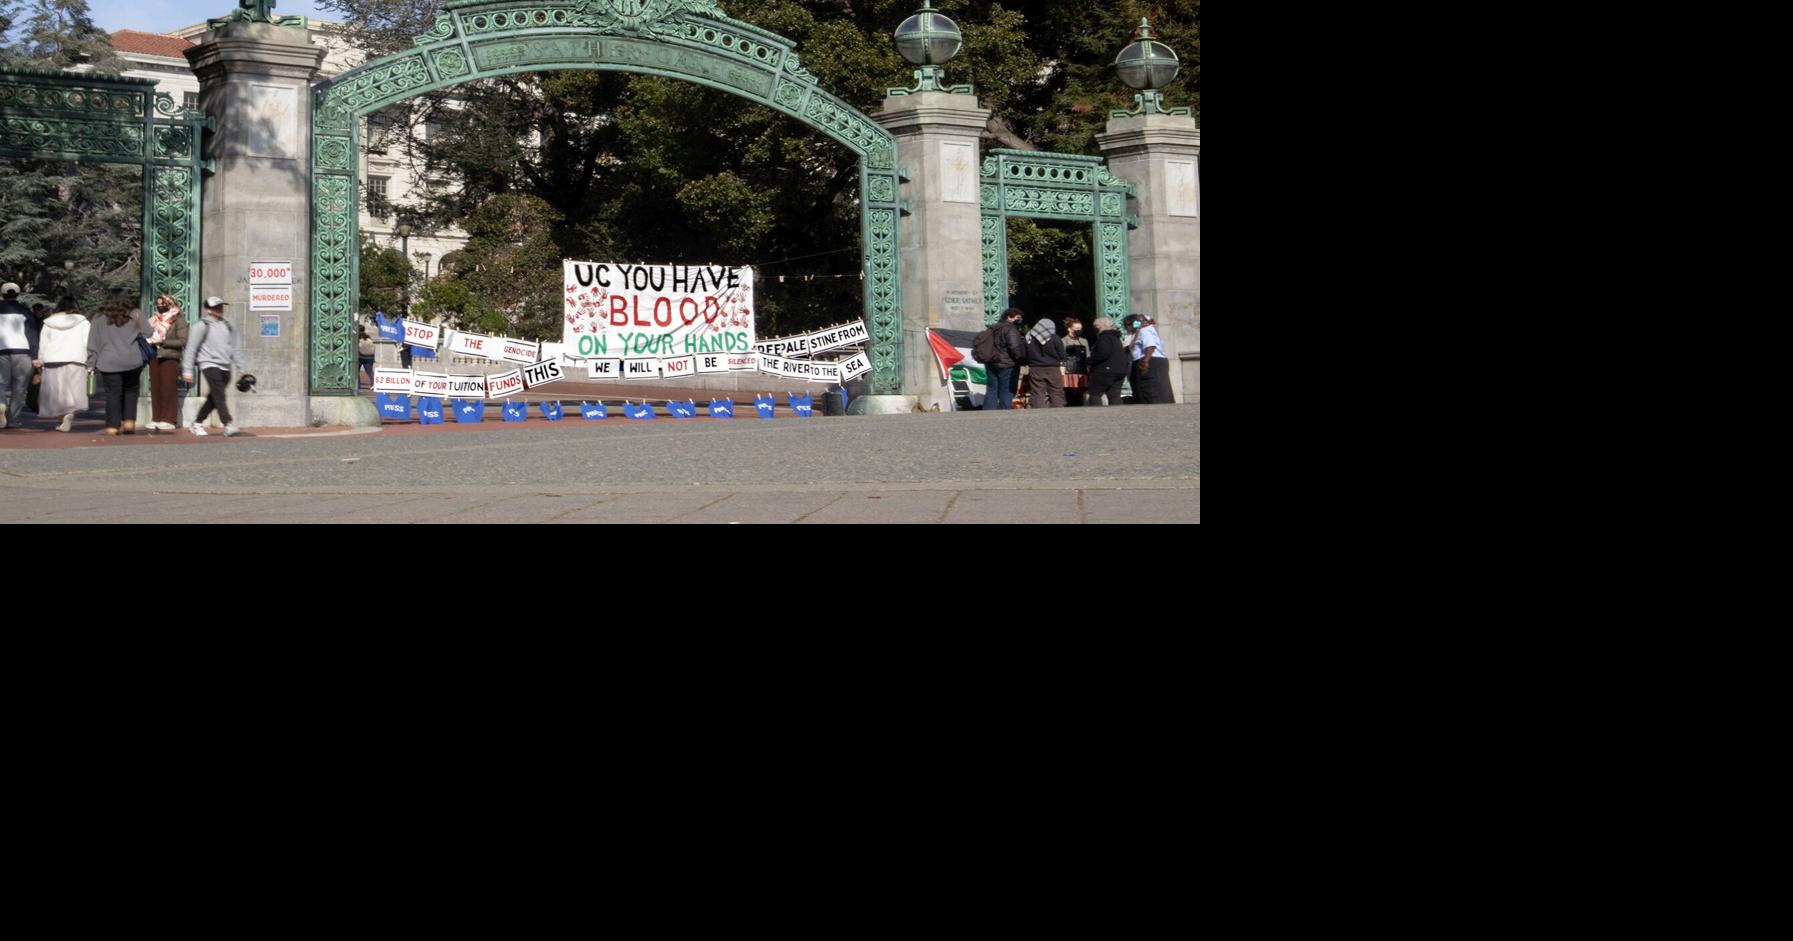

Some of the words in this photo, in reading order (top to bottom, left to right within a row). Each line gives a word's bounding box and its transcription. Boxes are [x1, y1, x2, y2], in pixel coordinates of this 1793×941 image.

[574, 264, 610, 288] UC
[616, 264, 665, 291] YOU
[673, 265, 740, 293] HAVE
[610, 295, 720, 327] BLOOD
[406, 327, 433, 341] STOP
[464, 337, 484, 350] THE
[503, 346, 536, 358] GENOCIDE
[578, 334, 607, 355] ON
[618, 332, 675, 356] YOUR
[685, 332, 749, 354] HANDS
[838, 325, 865, 341] FROM
[415, 380, 426, 388] OF
[428, 381, 447, 390] YOUR
[449, 381, 484, 391] TUITION
[489, 375, 521, 391] FUNDS
[525, 362, 559, 384] THIS
[595, 363, 610, 373] WE
[630, 362, 652, 373] WILL
[667, 360, 688, 372] NOT
[705, 357, 717, 367] BE
[728, 357, 756, 365] SILENCED
[762, 357, 779, 369] THE
[783, 361, 810, 372] RIVER
[810, 366, 820, 376] TO
[823, 367, 838, 376] THE
[845, 359, 864, 373] SEA
